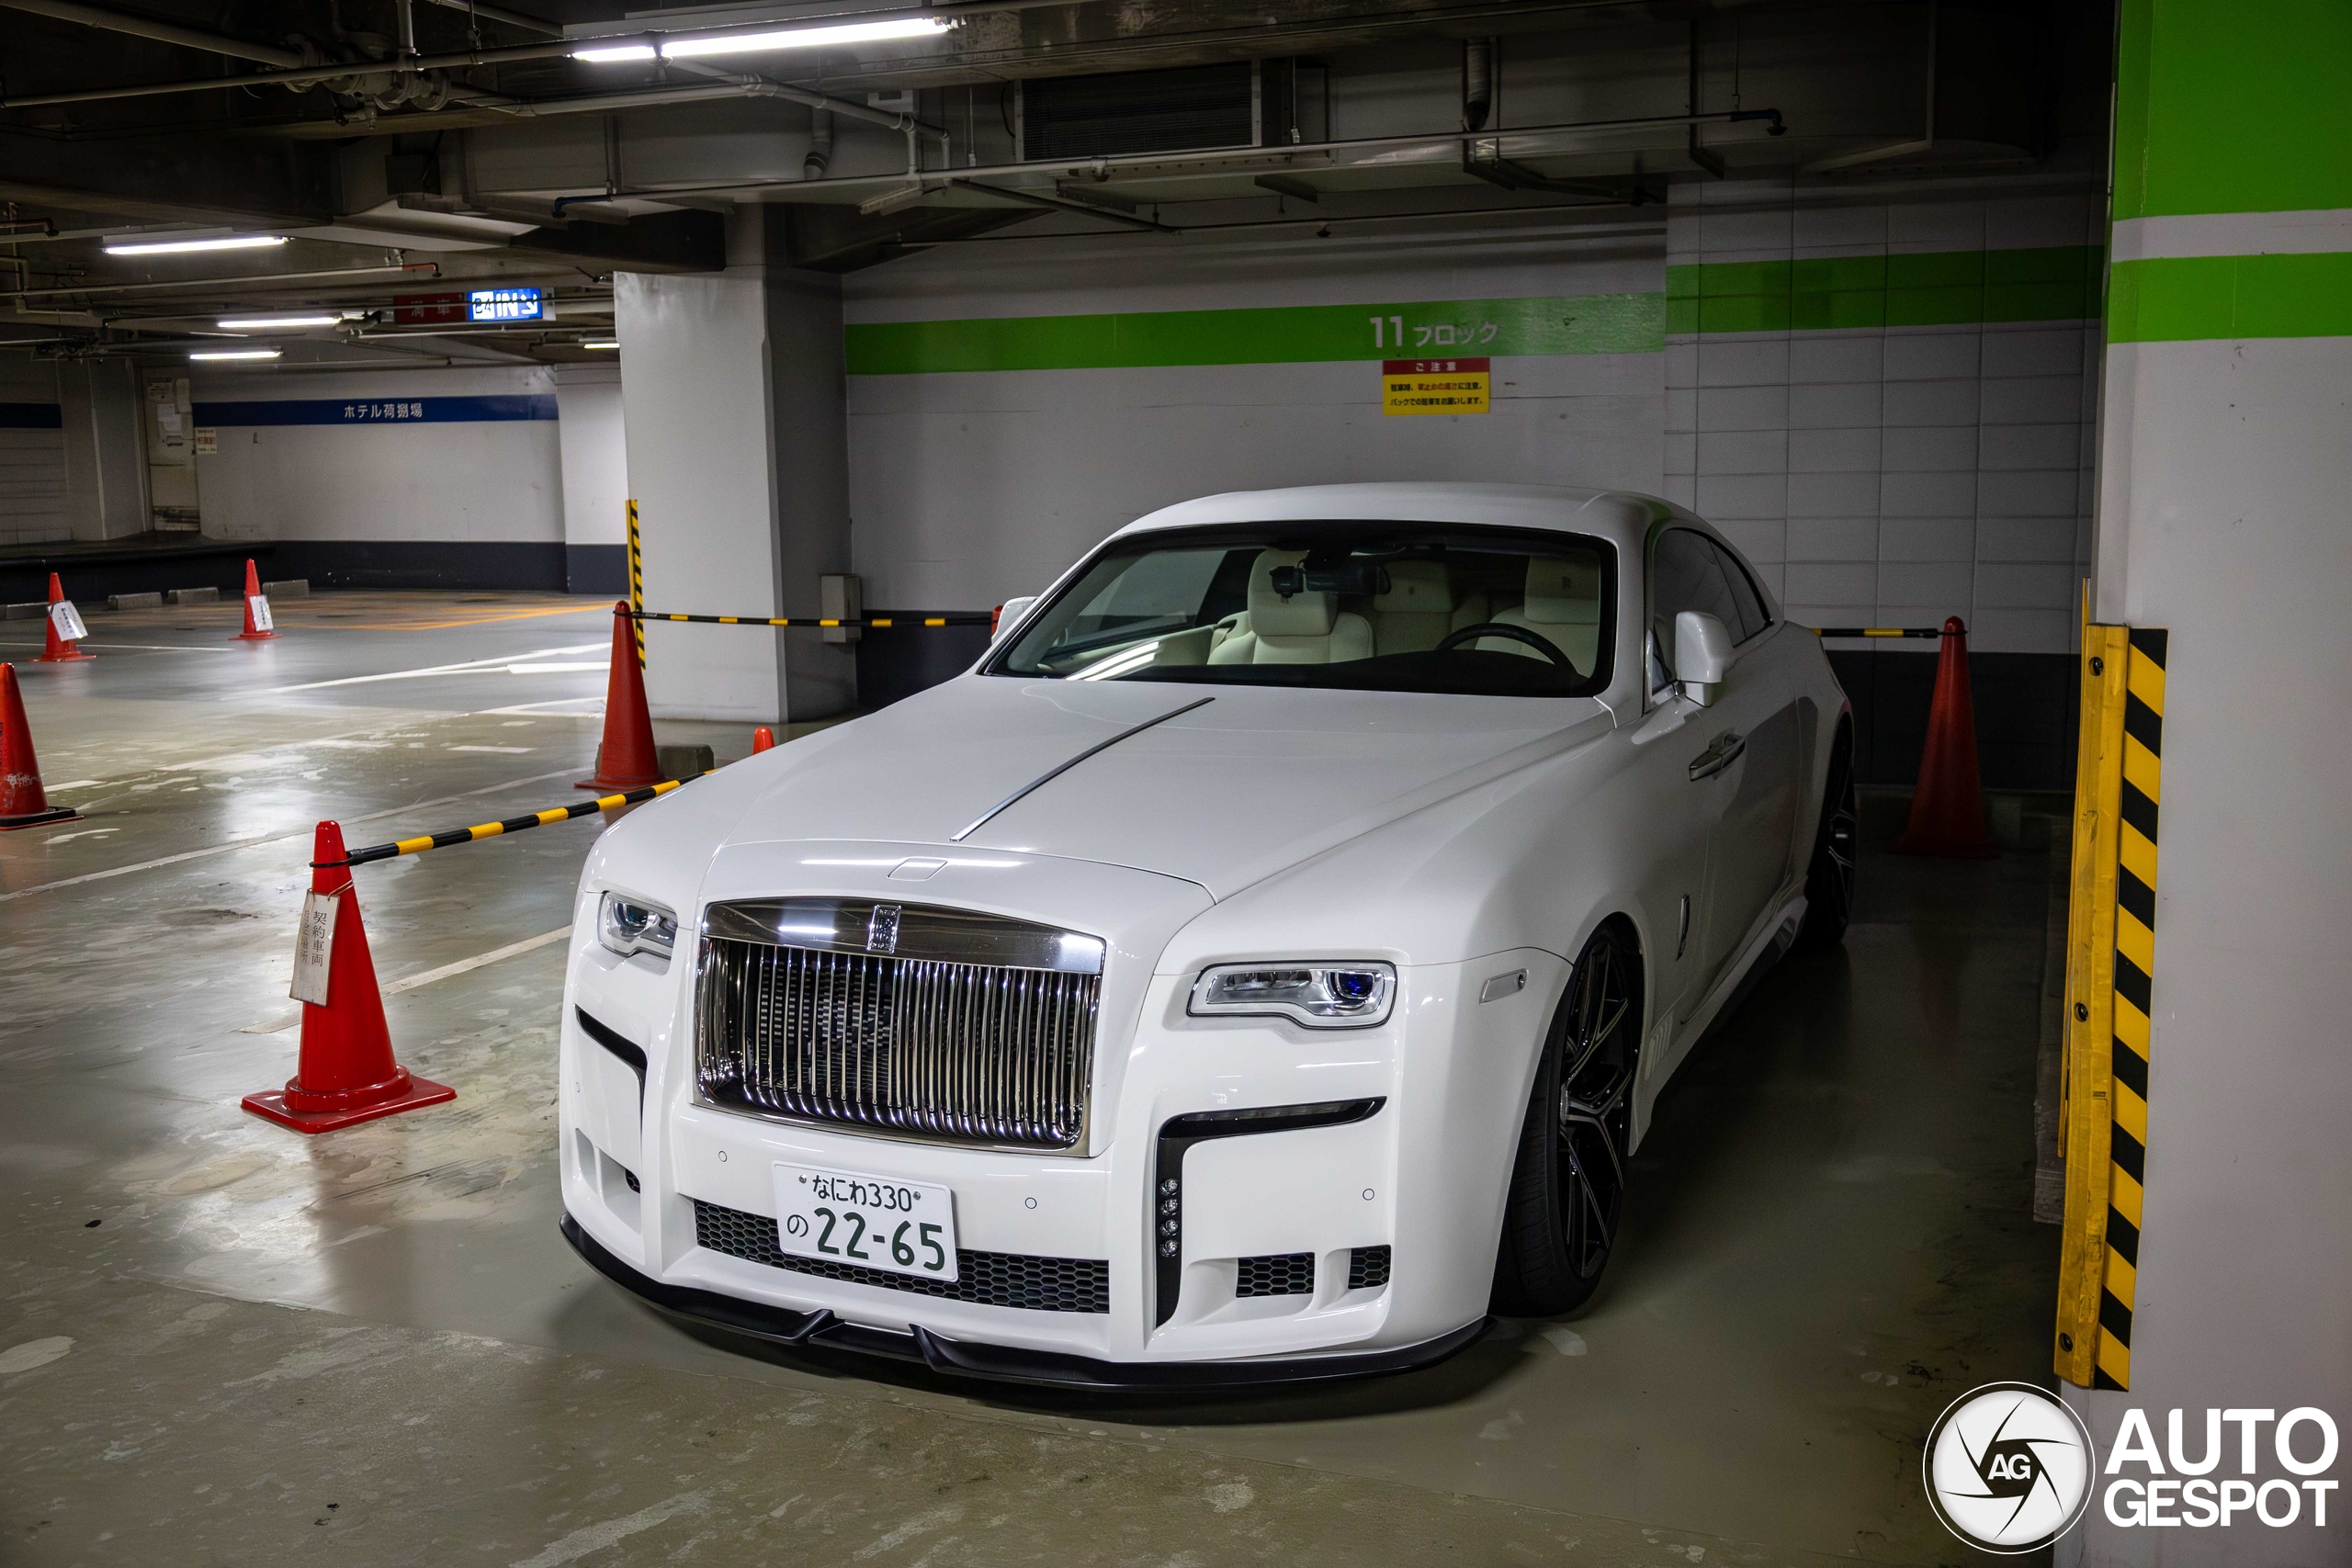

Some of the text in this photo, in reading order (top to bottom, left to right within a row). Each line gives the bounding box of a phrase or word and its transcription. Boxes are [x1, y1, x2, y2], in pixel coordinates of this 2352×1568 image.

[496, 292, 519, 318] IN
[1370, 316, 1498, 348] 11 ブロック
[311, 910, 327, 967] 契約車両
[786, 1207, 945, 1271] の 22-65
